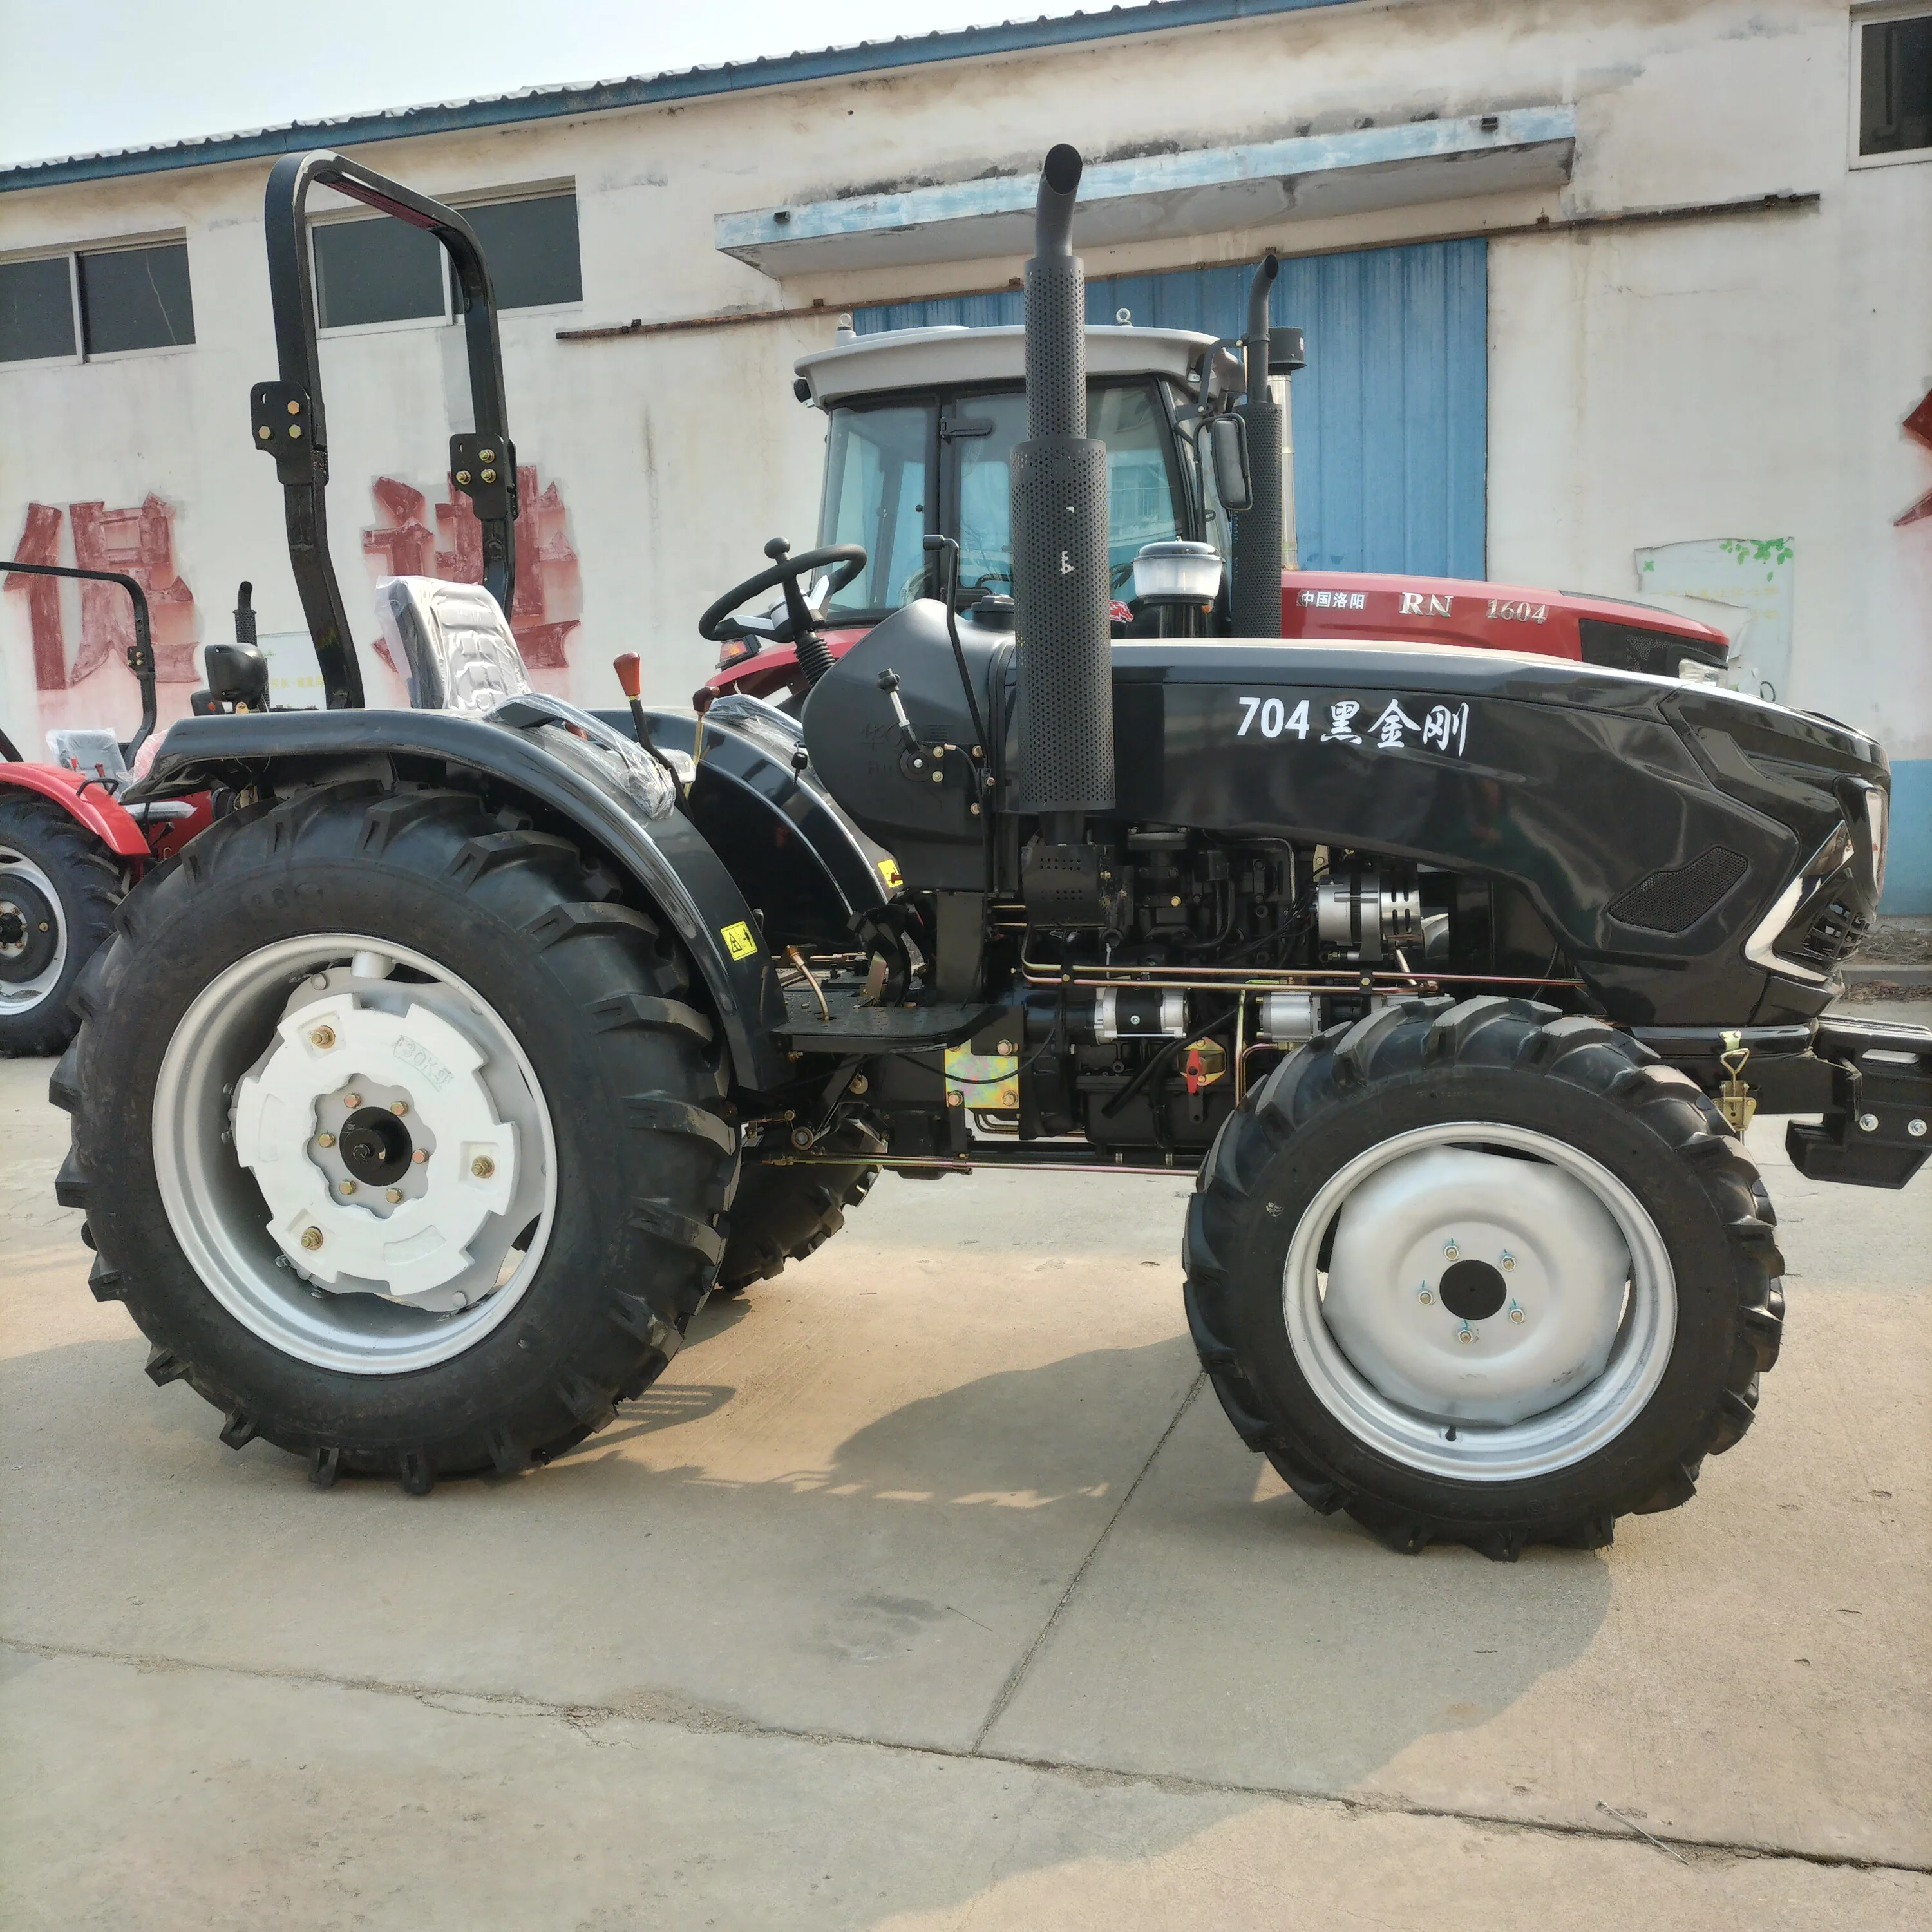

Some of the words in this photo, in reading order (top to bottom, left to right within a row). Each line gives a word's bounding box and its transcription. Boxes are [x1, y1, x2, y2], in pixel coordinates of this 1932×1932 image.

[1301, 591, 1365, 609] 中国洛阳
[1399, 591, 1454, 618] RN
[1487, 598, 1548, 624] 1604
[1237, 697, 1309, 739] 704
[1320, 699, 1470, 757] 黑金刚
